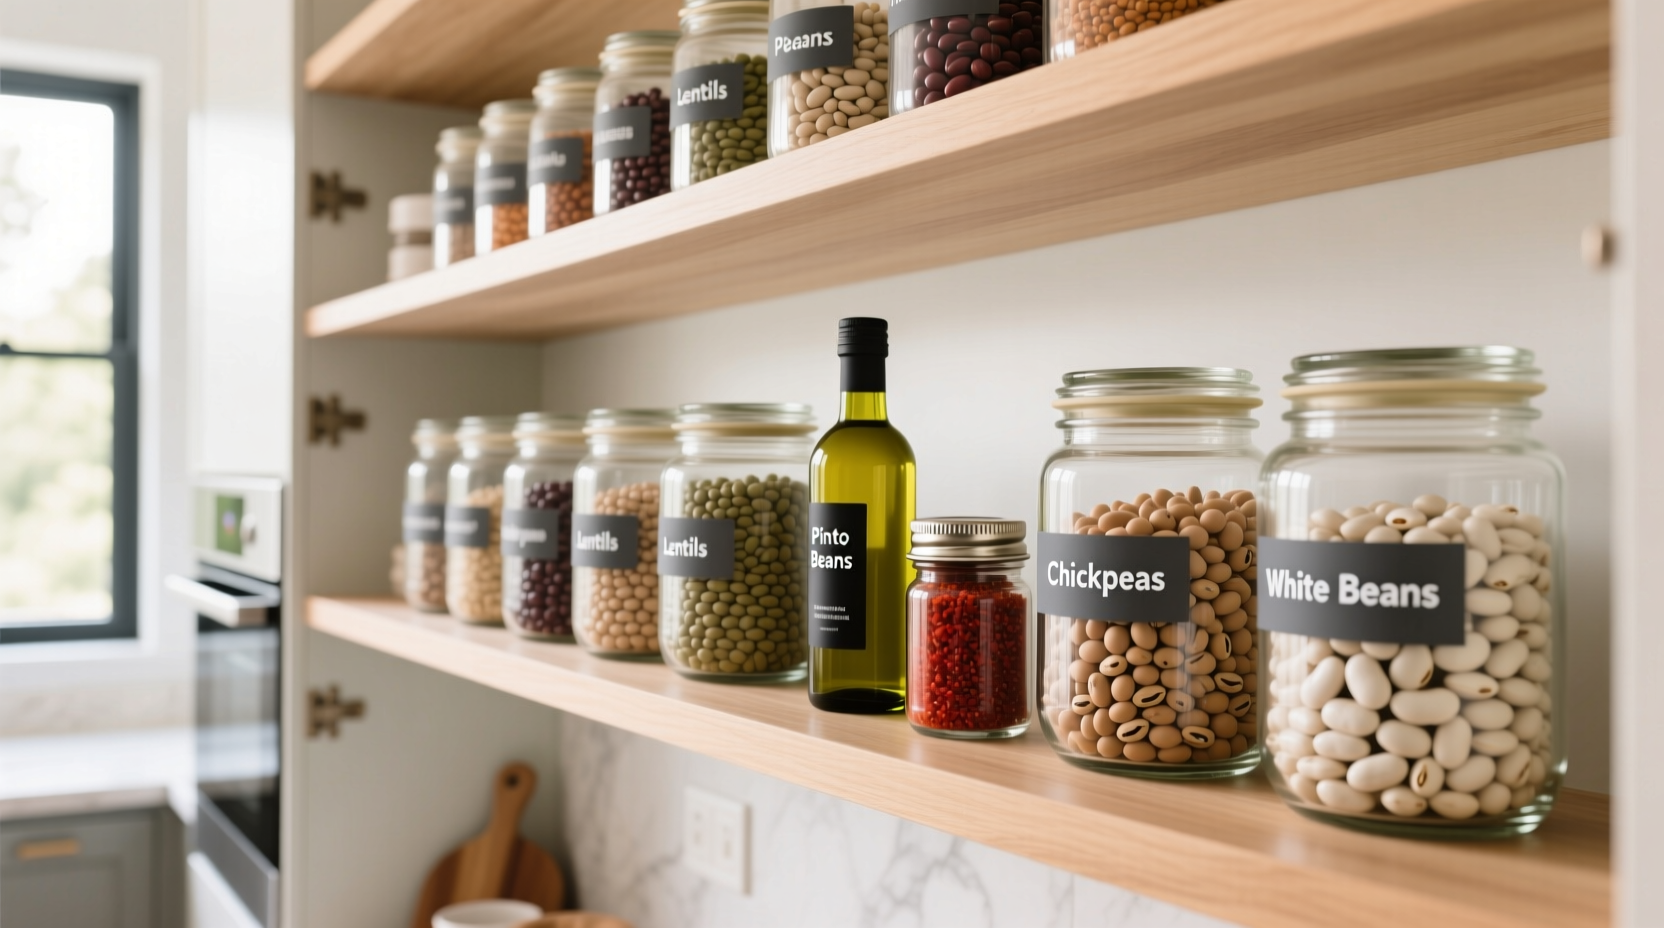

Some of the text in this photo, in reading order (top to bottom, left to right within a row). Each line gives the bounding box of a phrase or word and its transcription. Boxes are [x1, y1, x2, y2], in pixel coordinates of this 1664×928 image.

[677, 79, 728, 106] Lentils
[663, 536, 708, 558] Lentils
[811, 526, 850, 546] Pinto
[810, 550, 853, 570] Beans
[1047, 560, 1166, 598] Chickpeas
[1265, 567, 1441, 610] White Beans
